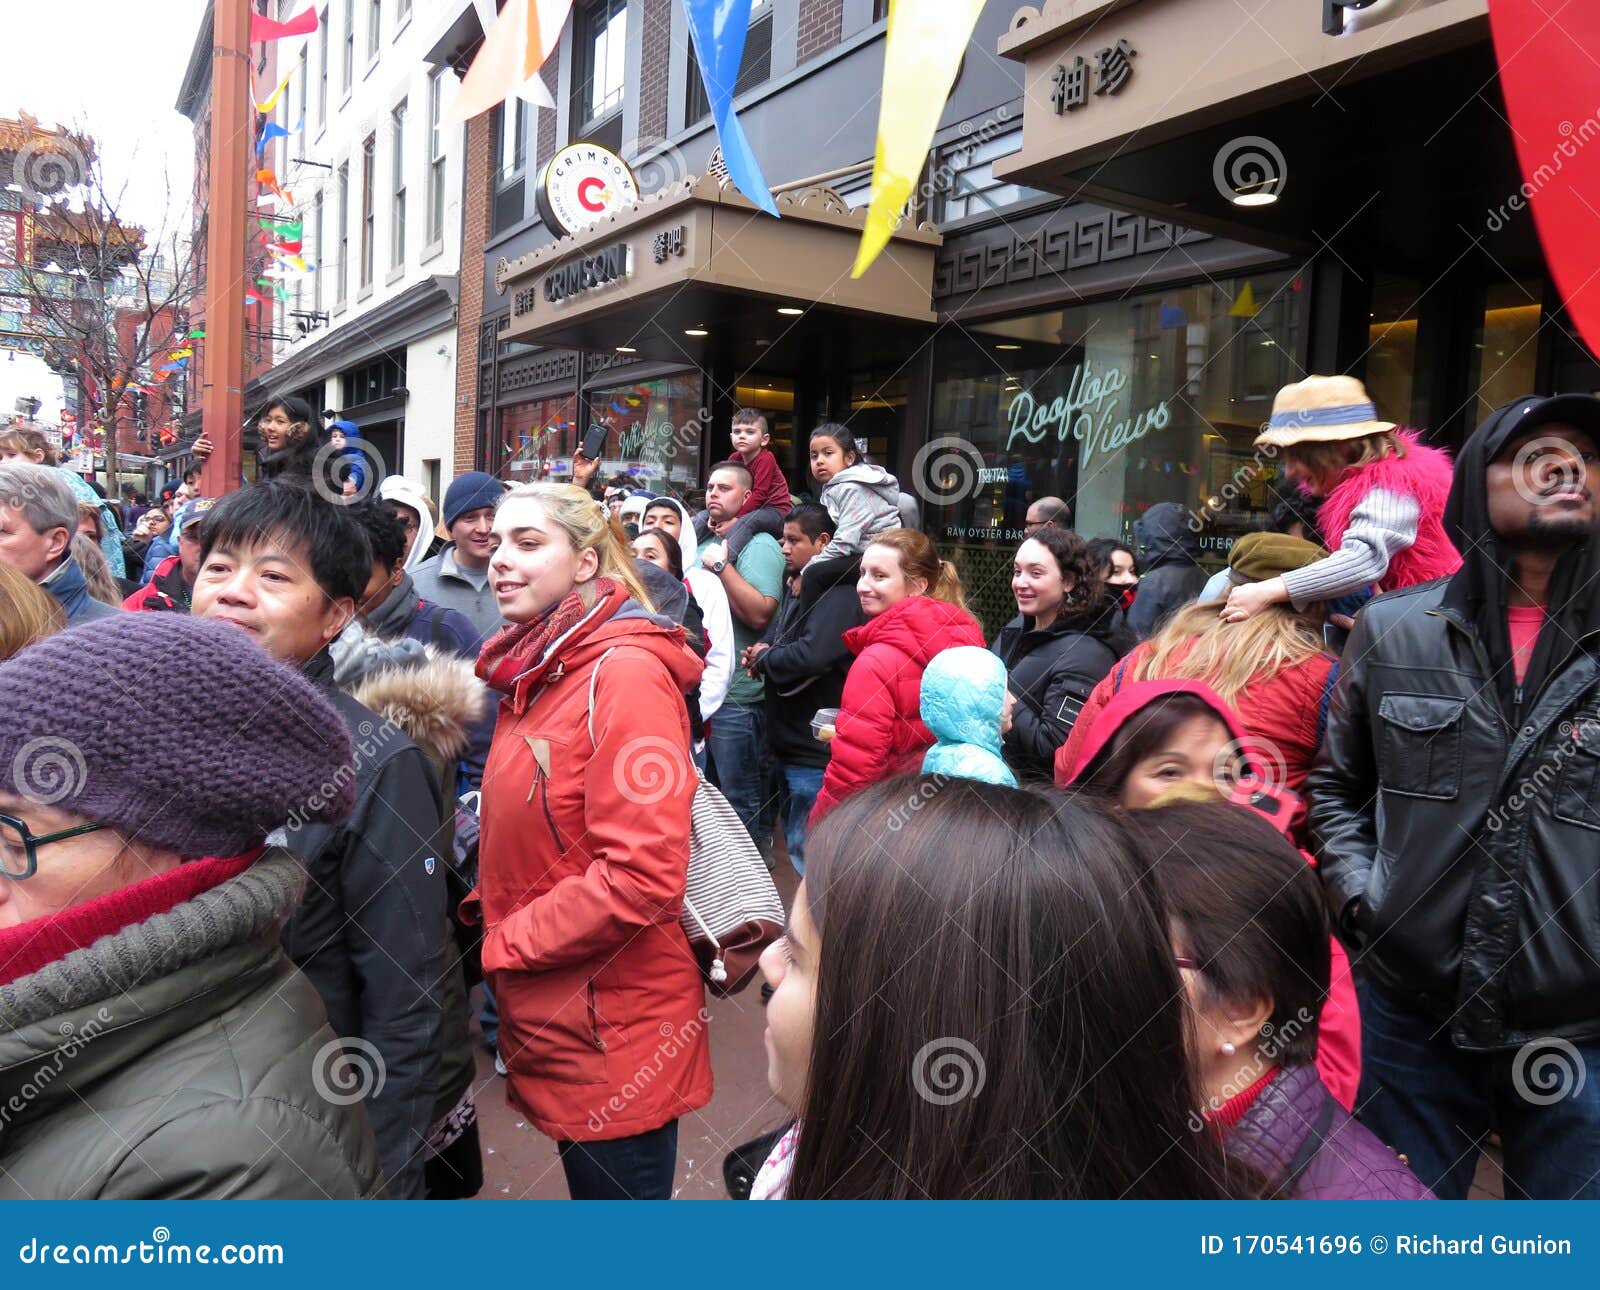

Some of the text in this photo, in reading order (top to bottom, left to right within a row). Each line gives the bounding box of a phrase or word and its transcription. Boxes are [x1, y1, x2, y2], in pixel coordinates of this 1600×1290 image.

[1051, 39, 1136, 115] 袖珍
[556, 151, 631, 188] CRIMSON
[543, 243, 629, 302] CRIMSON
[1006, 359, 1126, 451] Rooftop
[1074, 400, 1169, 470] Views
[947, 527, 1024, 540] RAW OYSTER BAR
